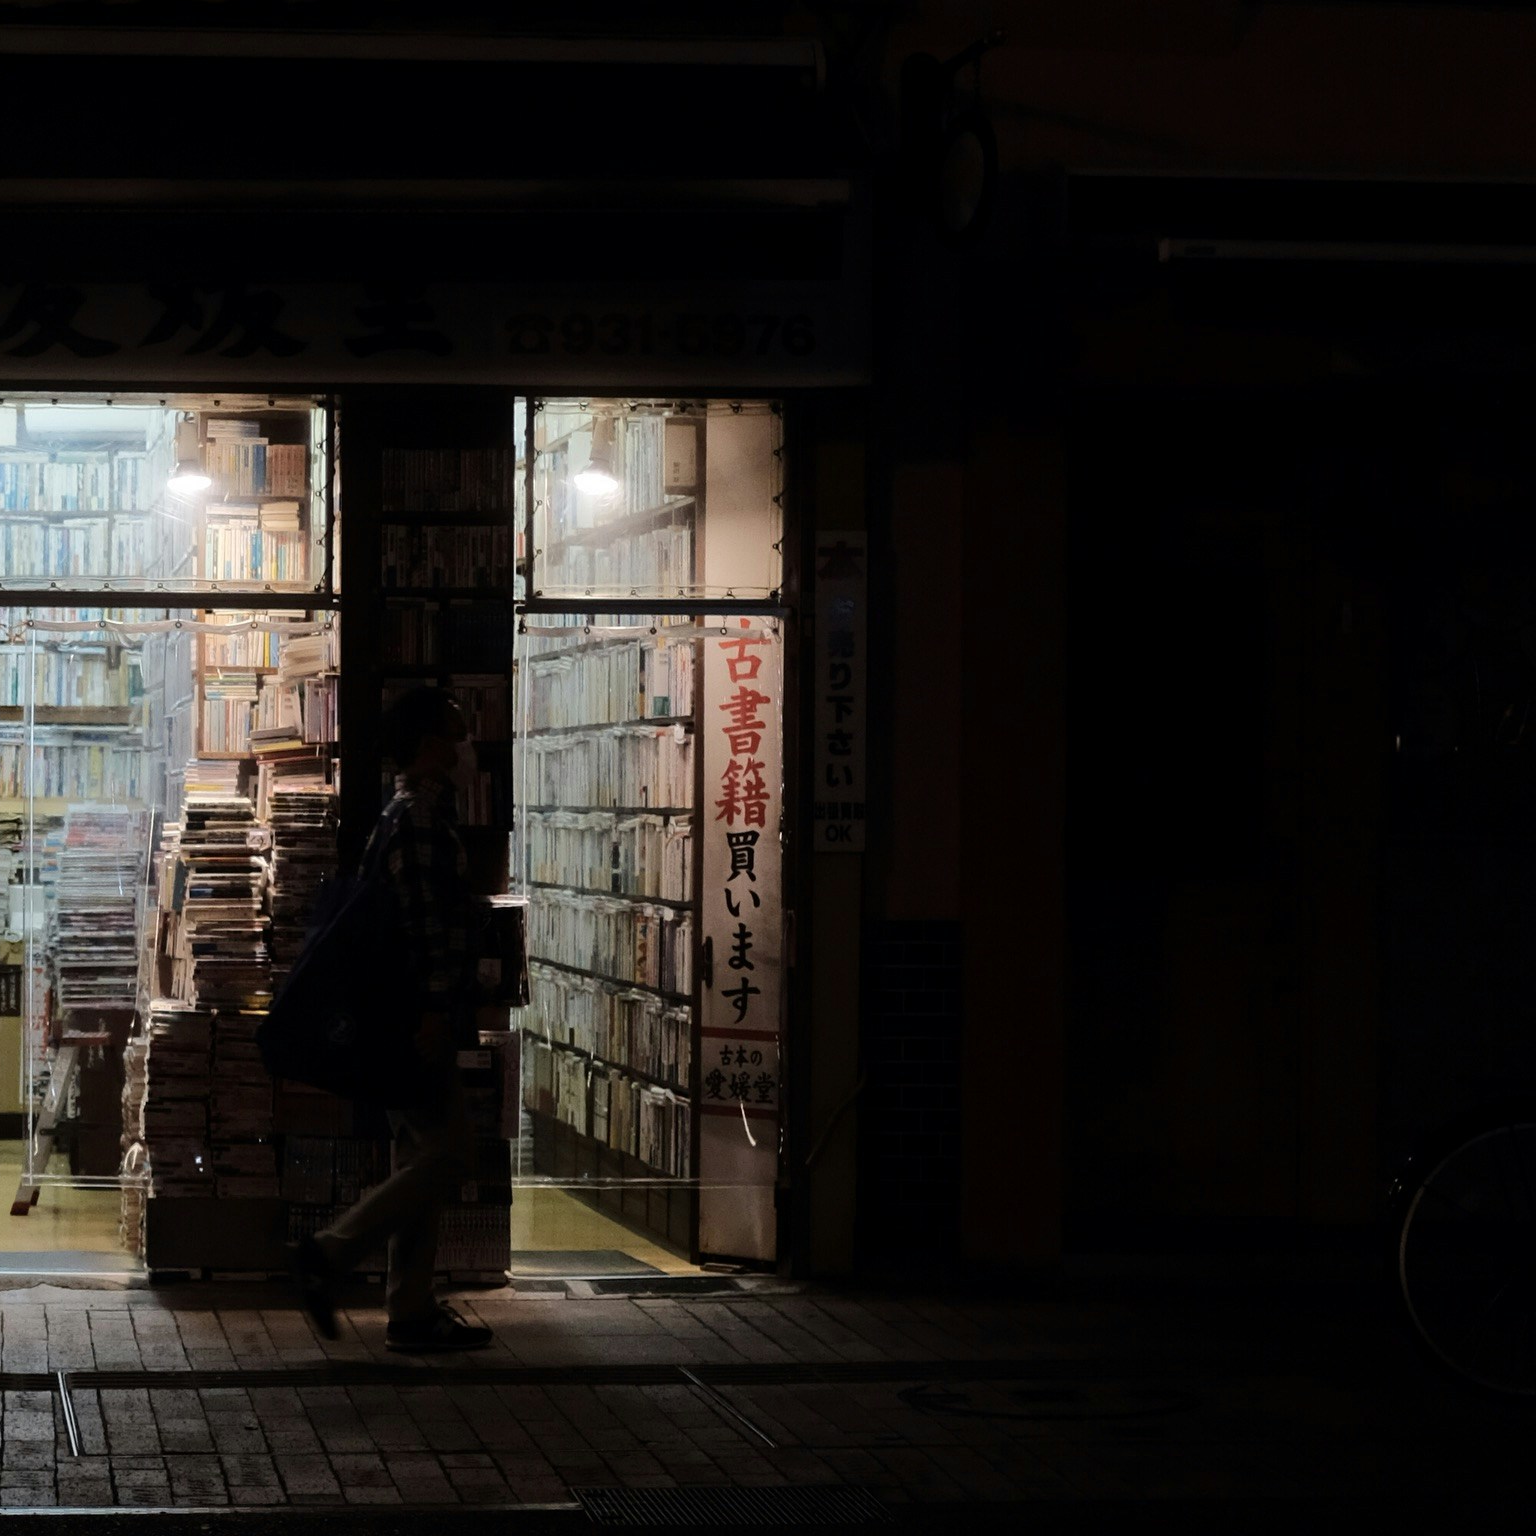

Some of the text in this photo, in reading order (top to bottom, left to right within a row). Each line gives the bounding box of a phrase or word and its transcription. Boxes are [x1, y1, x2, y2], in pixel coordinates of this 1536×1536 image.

[714, 619, 774, 1025] 古書籍買います
[825, 824, 853, 843] OK
[719, 1044, 763, 1068] 古本の
[705, 1068, 776, 1104] 愛媛堂
